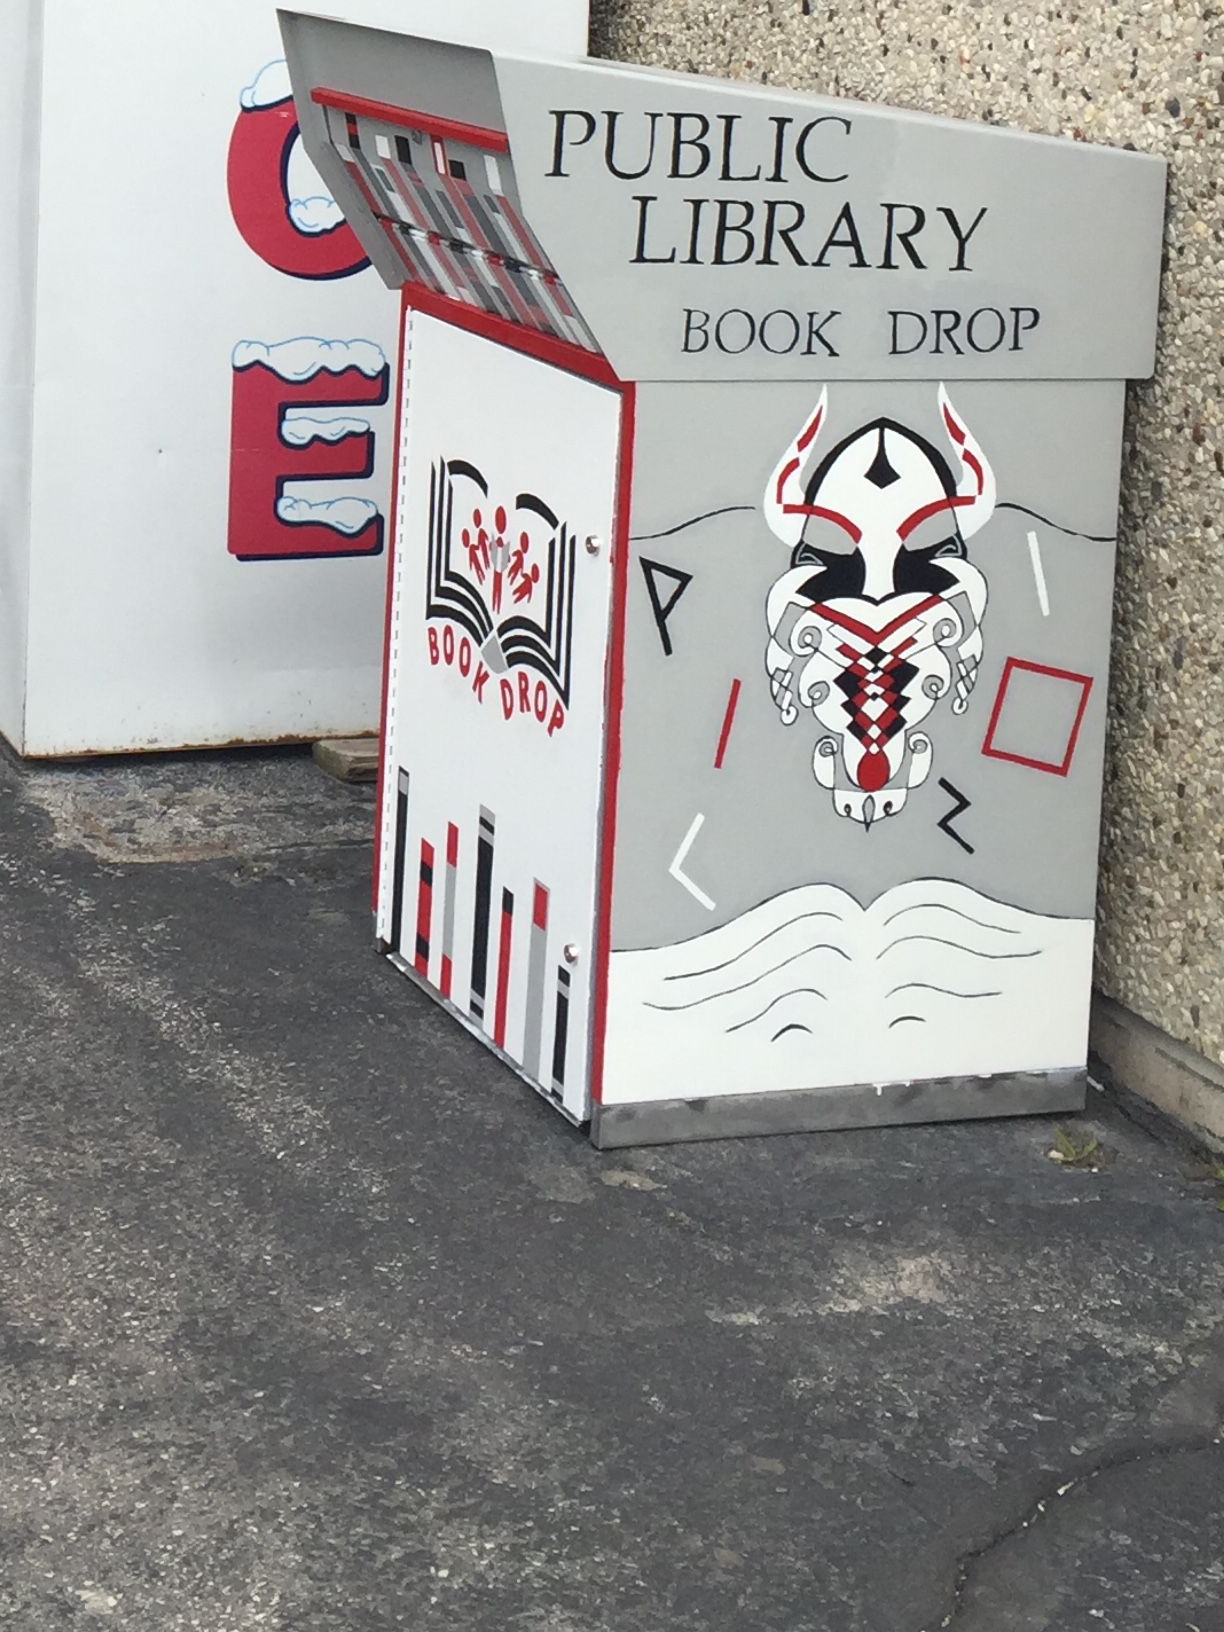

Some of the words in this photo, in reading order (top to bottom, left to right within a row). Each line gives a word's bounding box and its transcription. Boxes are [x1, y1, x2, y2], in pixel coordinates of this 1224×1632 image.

[544, 109, 853, 183] PUBLIC
[629, 195, 988, 272] LIBRARY
[680, 308, 842, 357] BOOK
[887, 306, 1041, 356] DROP
[427, 624, 489, 704] BOOK
[499, 670, 565, 737] DROP
